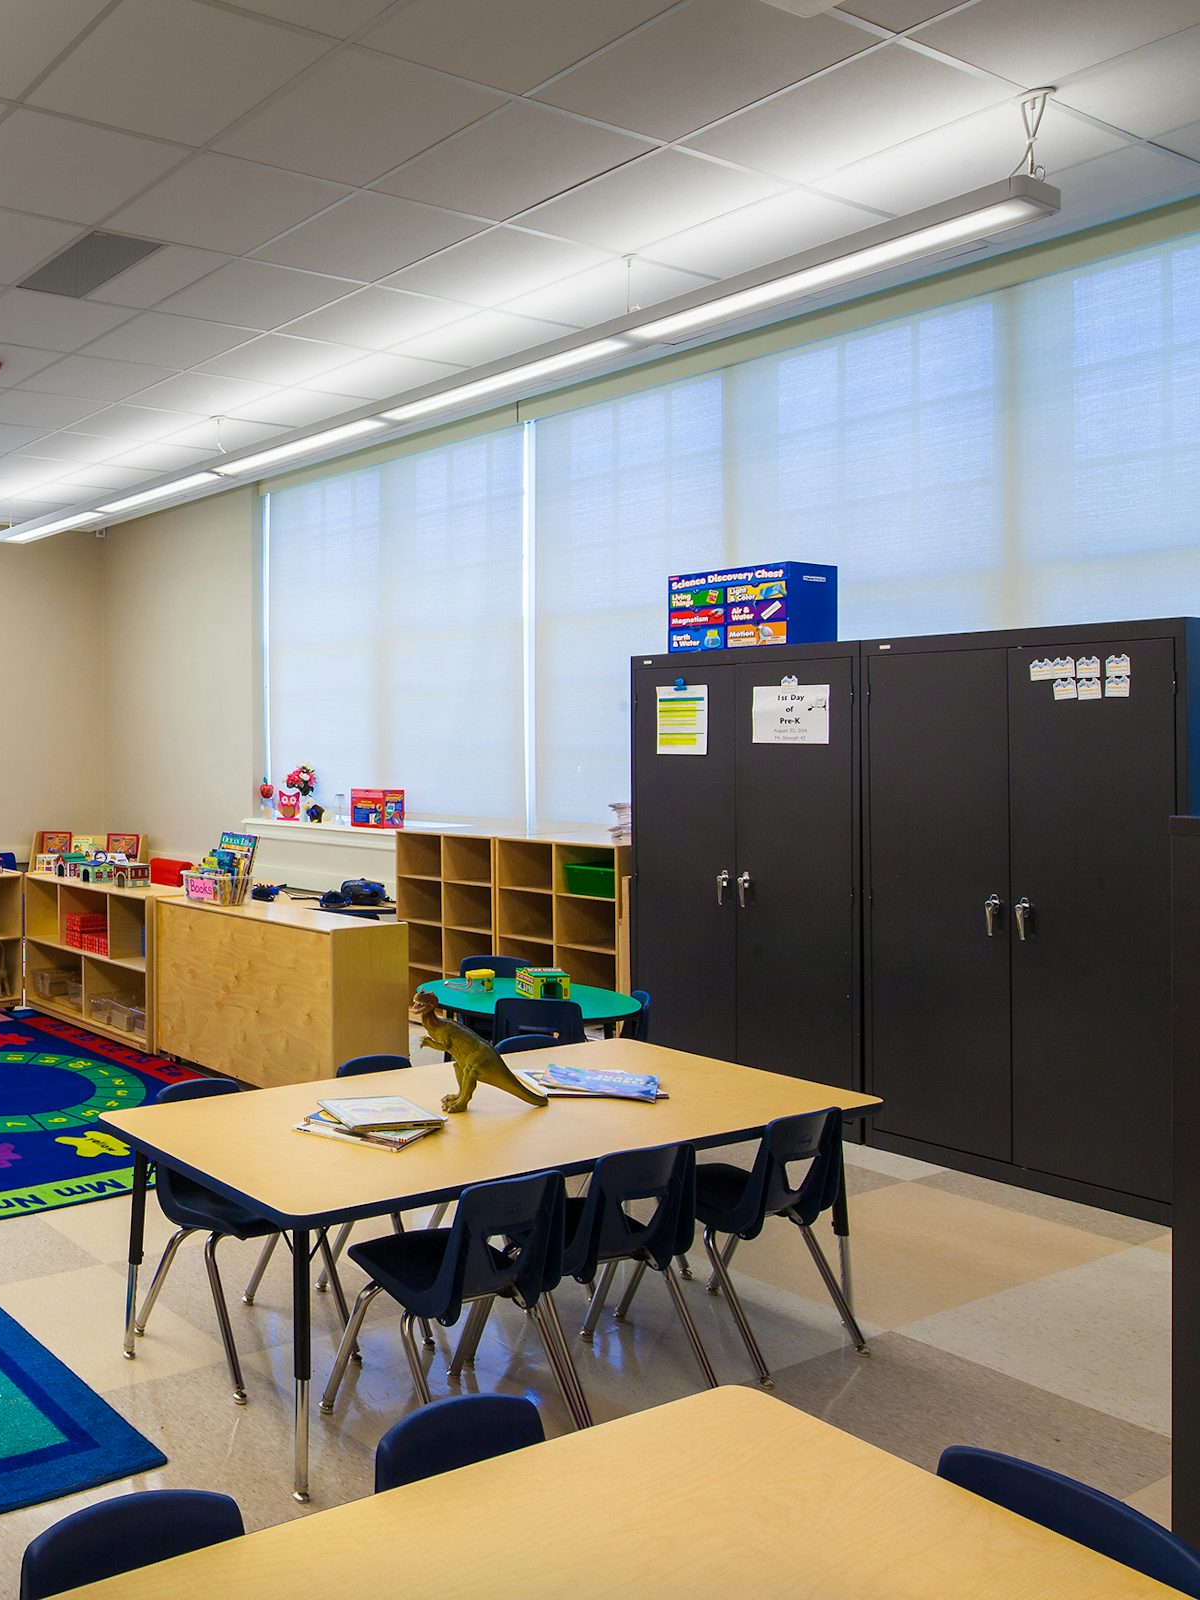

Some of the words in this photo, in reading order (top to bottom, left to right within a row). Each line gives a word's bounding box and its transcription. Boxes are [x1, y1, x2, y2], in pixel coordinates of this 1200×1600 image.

[672, 577, 706, 590] Science
[707, 570, 754, 583] Discovery
[755, 568, 784, 579] Chest
[729, 587, 747, 596] Light
[672, 593, 692, 602] Living
[737, 593, 757, 602] Color
[672, 599, 694, 607] Things
[731, 606, 742, 614] Air
[671, 615, 709, 626] Magnetism
[731, 613, 755, 621] Water
[672, 633, 691, 642] Earth
[729, 630, 755, 639] Motion
[679, 639, 700, 648] Water
[777, 693, 789, 702] 1st
[790, 693, 805, 703] Day
[785, 705, 794, 714] of
[779, 716, 801, 726] Pre-K
[189, 878, 213, 895] Books
[84, 1137, 118, 1152] yellow
[53, 1178, 128, 1198] Mm
